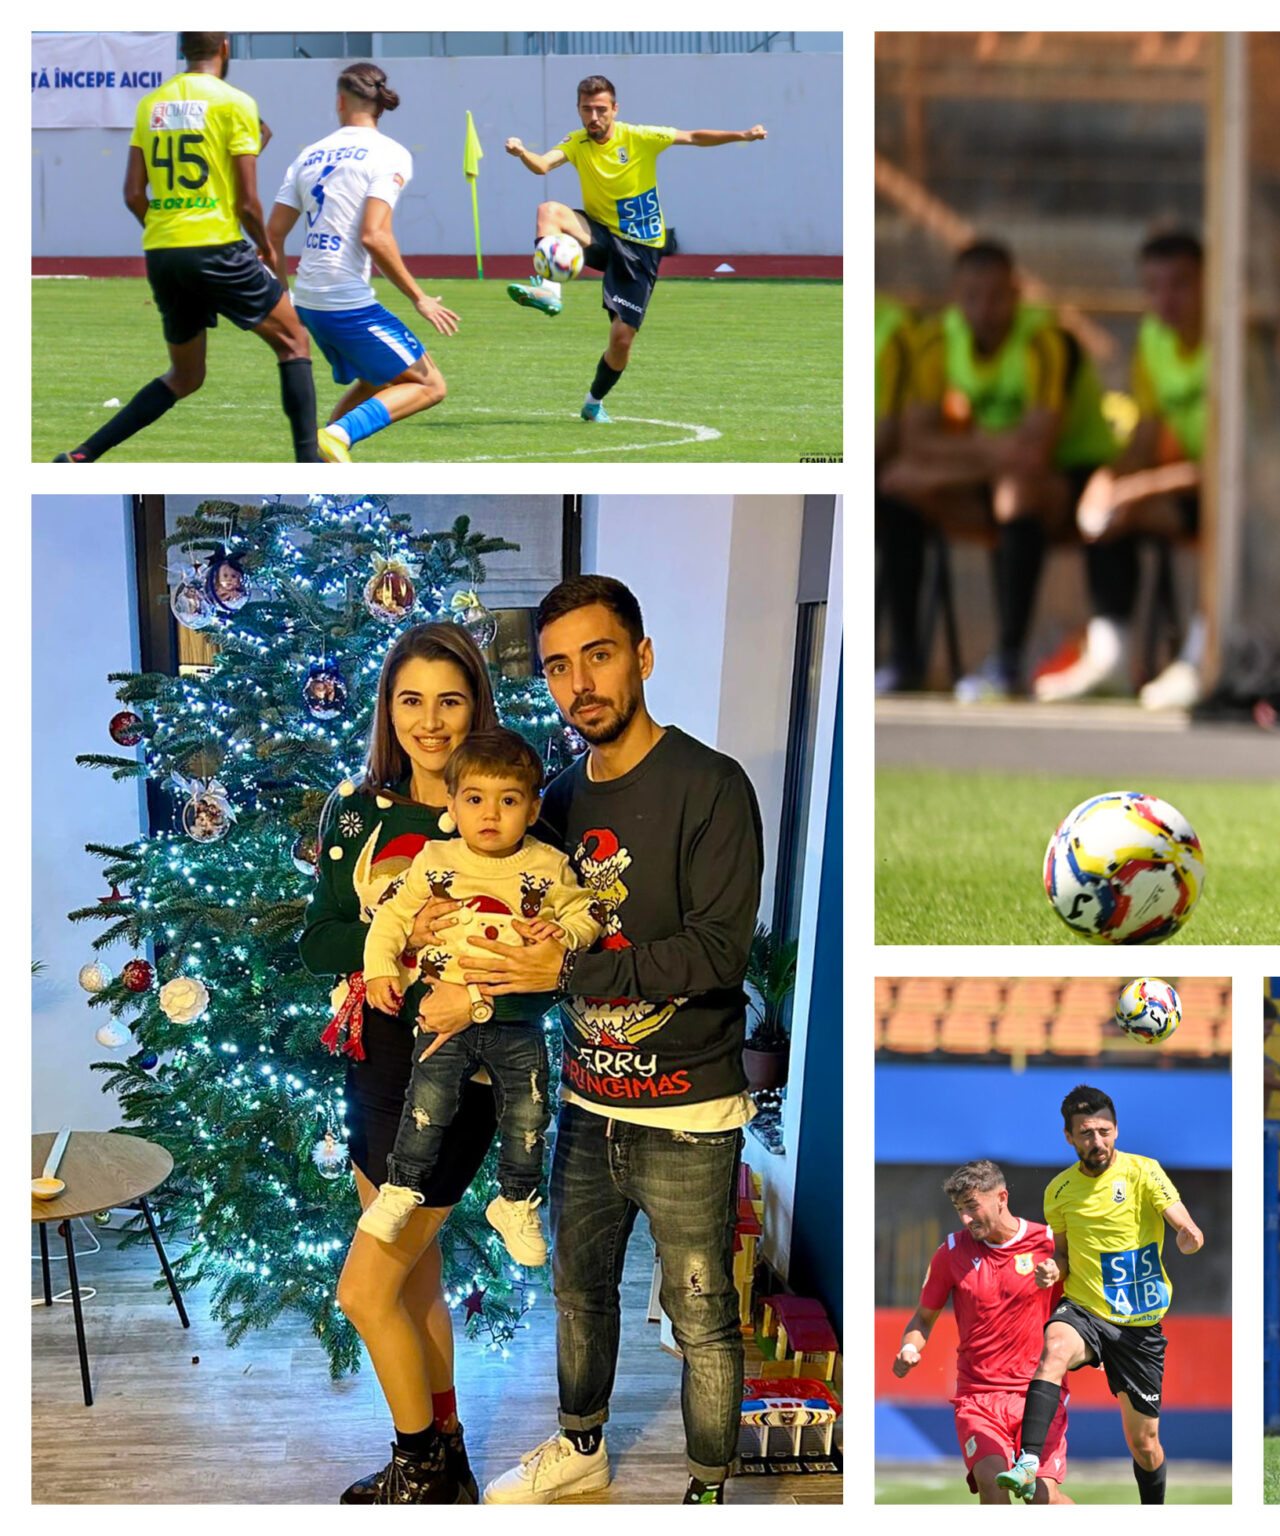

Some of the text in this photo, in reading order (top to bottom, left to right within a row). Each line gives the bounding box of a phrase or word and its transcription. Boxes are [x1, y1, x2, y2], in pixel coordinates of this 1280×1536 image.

[54, 67, 115, 89] ÎNCEPE
[119, 71, 162, 89] AICI!
[152, 134, 210, 191] 45
